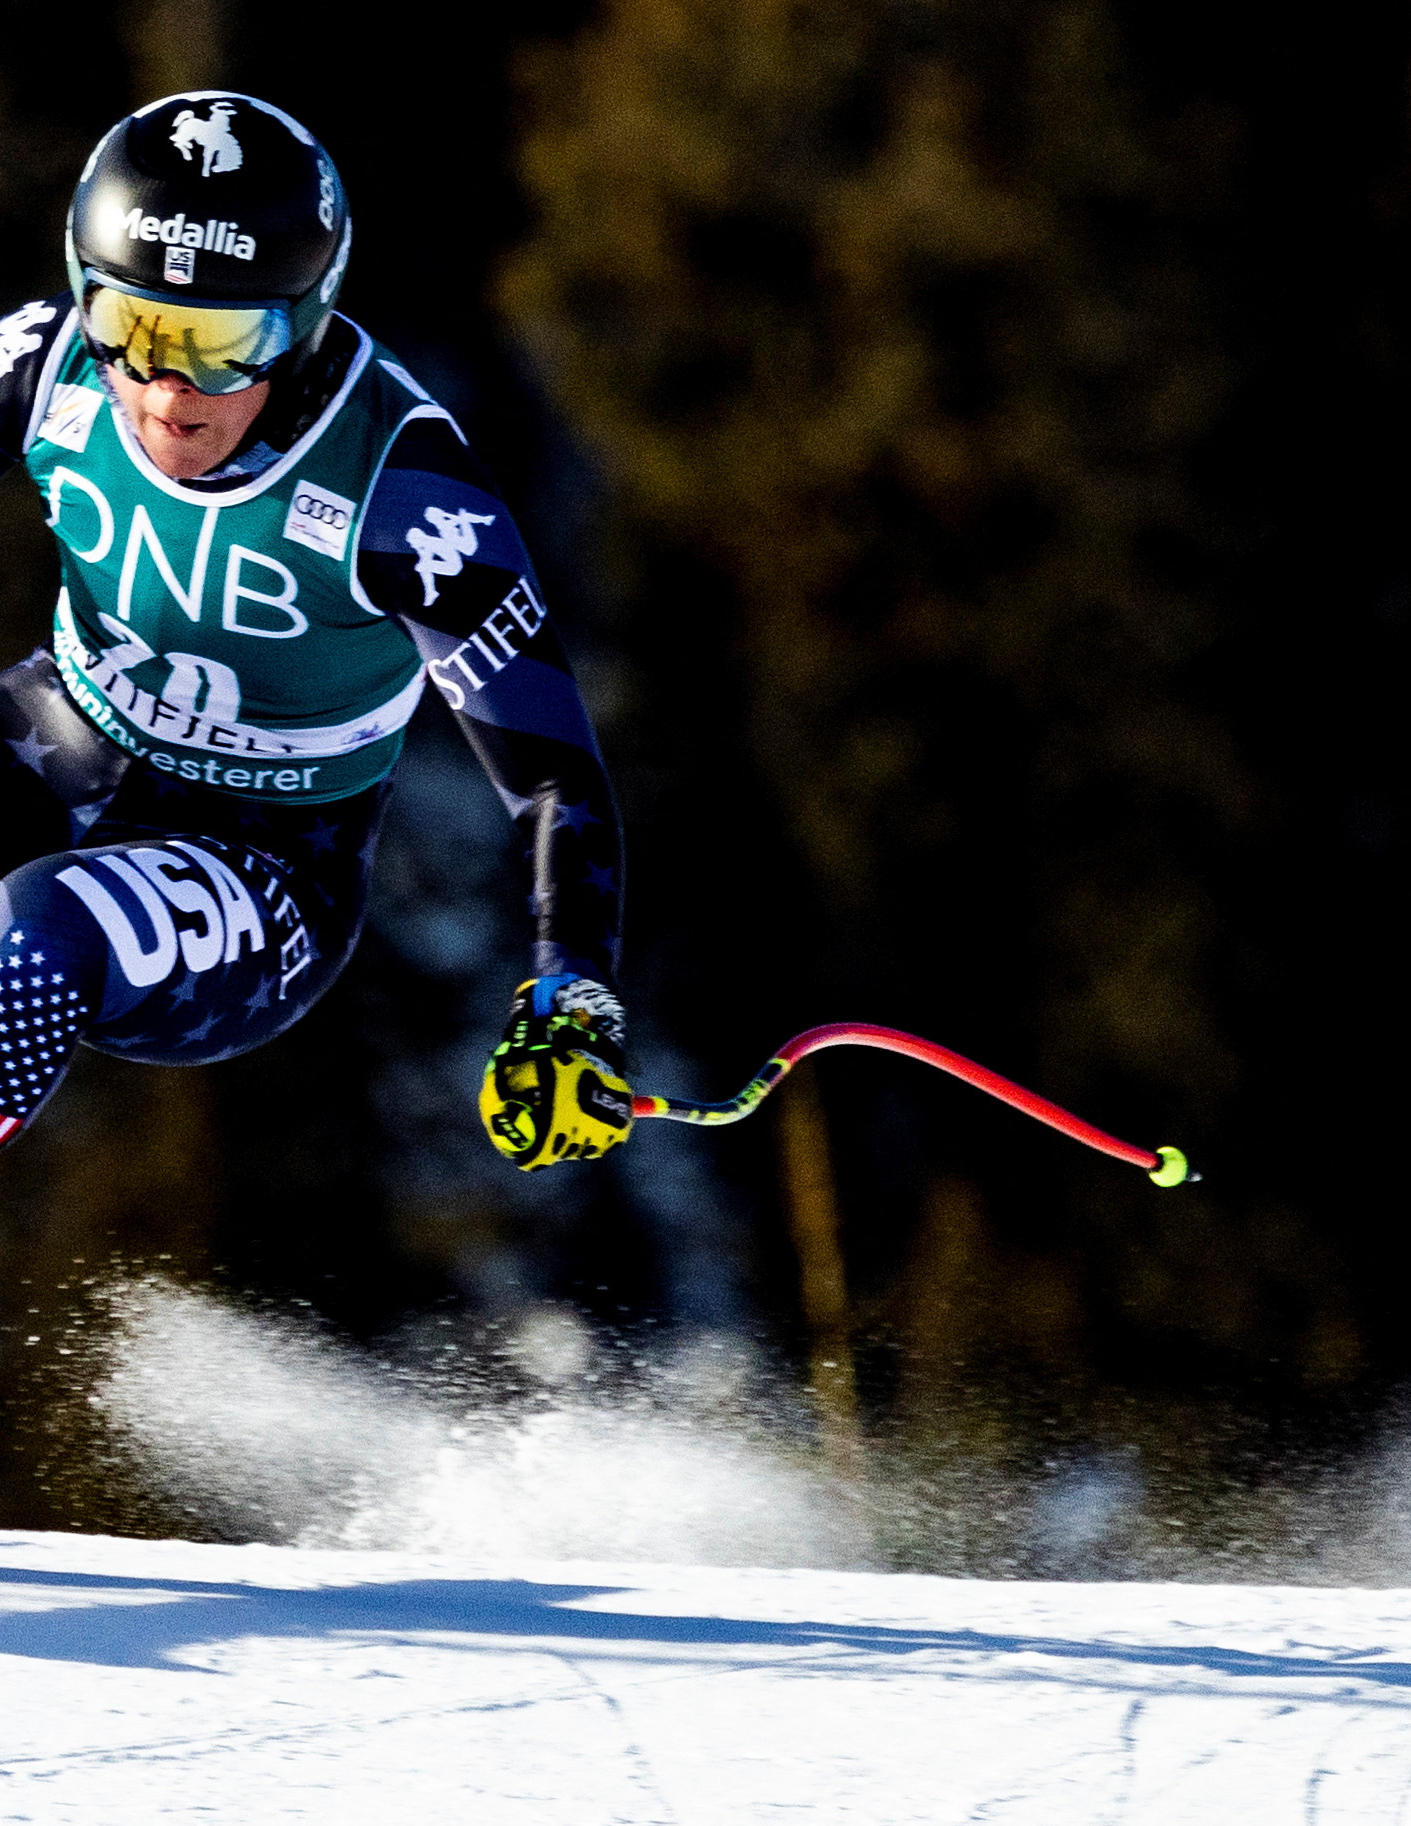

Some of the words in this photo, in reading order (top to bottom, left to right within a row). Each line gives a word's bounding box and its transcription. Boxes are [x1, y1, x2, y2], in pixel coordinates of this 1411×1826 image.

[113, 207, 256, 260] Medallia
[45, 464, 309, 639] DNB
[55, 840, 266, 988] USA
